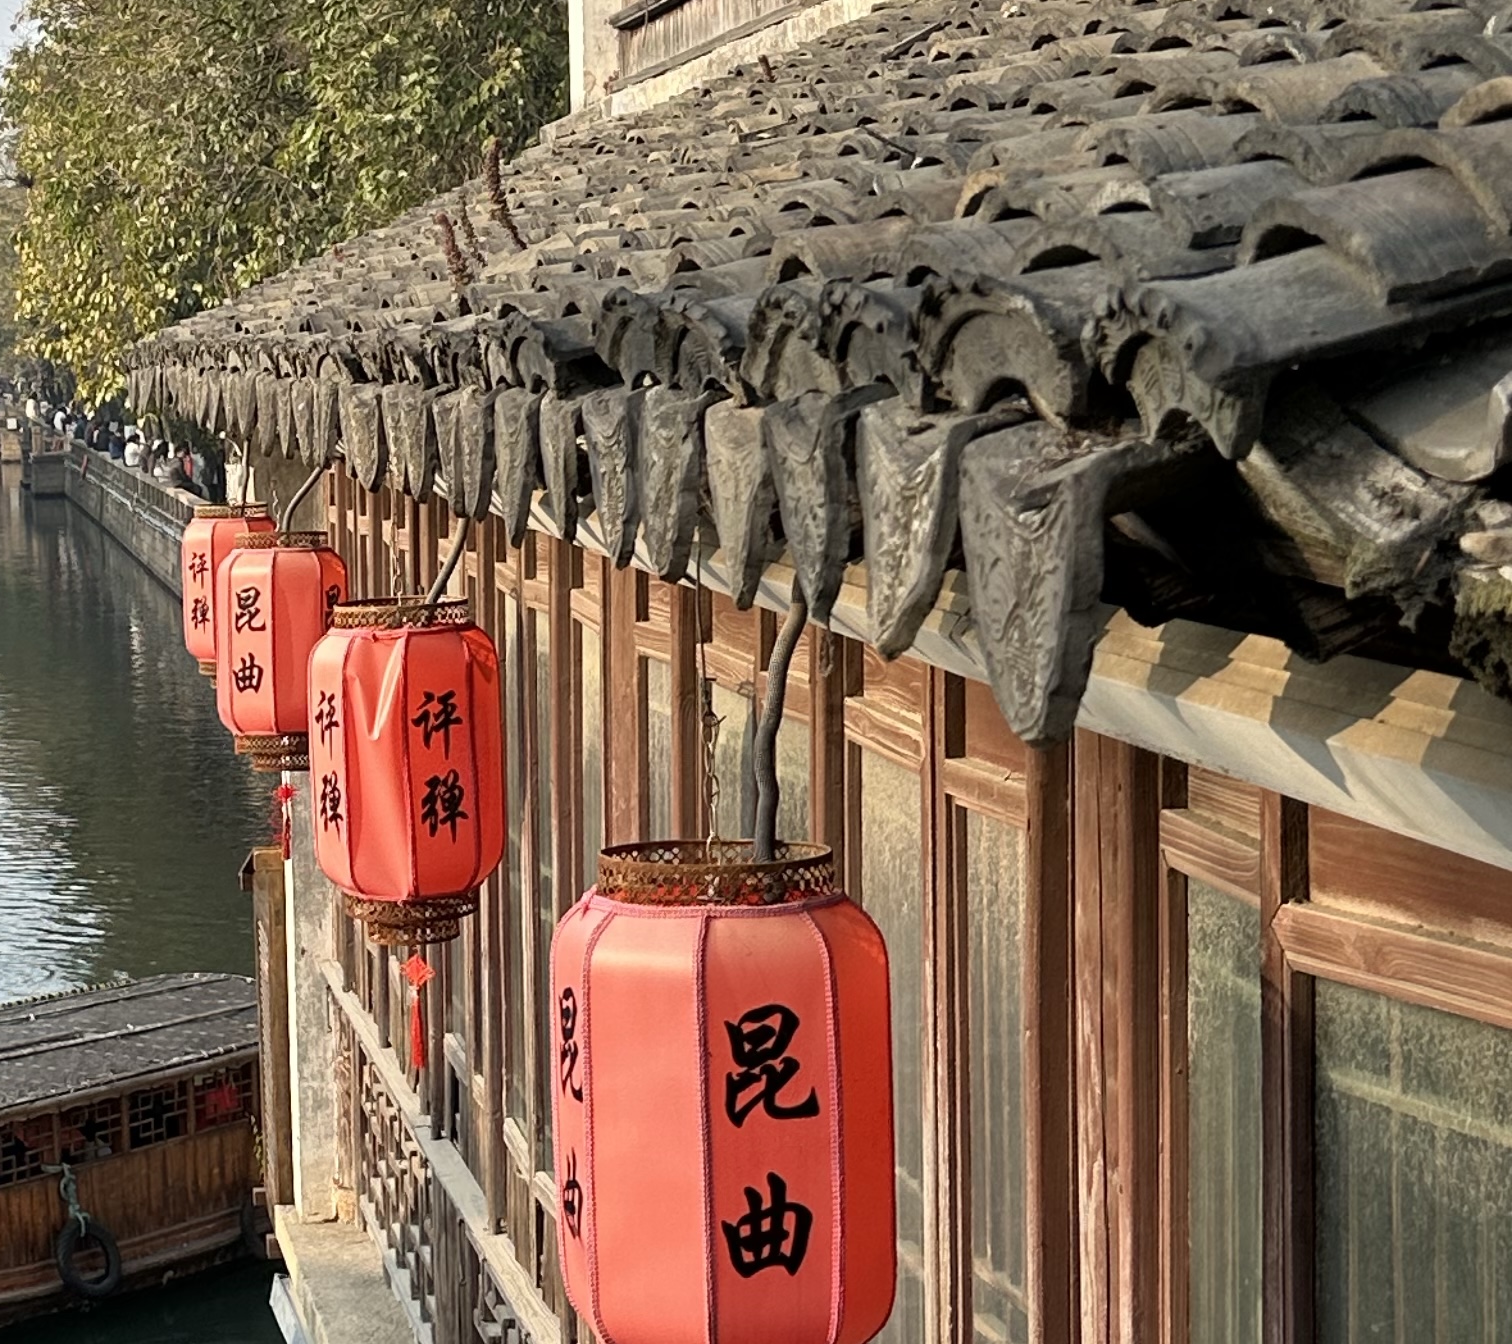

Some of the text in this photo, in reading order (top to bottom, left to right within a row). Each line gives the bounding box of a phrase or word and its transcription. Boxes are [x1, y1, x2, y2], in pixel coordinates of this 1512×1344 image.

[232, 585, 267, 694] 昆曲
[411, 689, 469, 844] 评弹
[560, 987, 583, 1239] 昆曲
[720, 1003, 819, 1279] 昆曲
